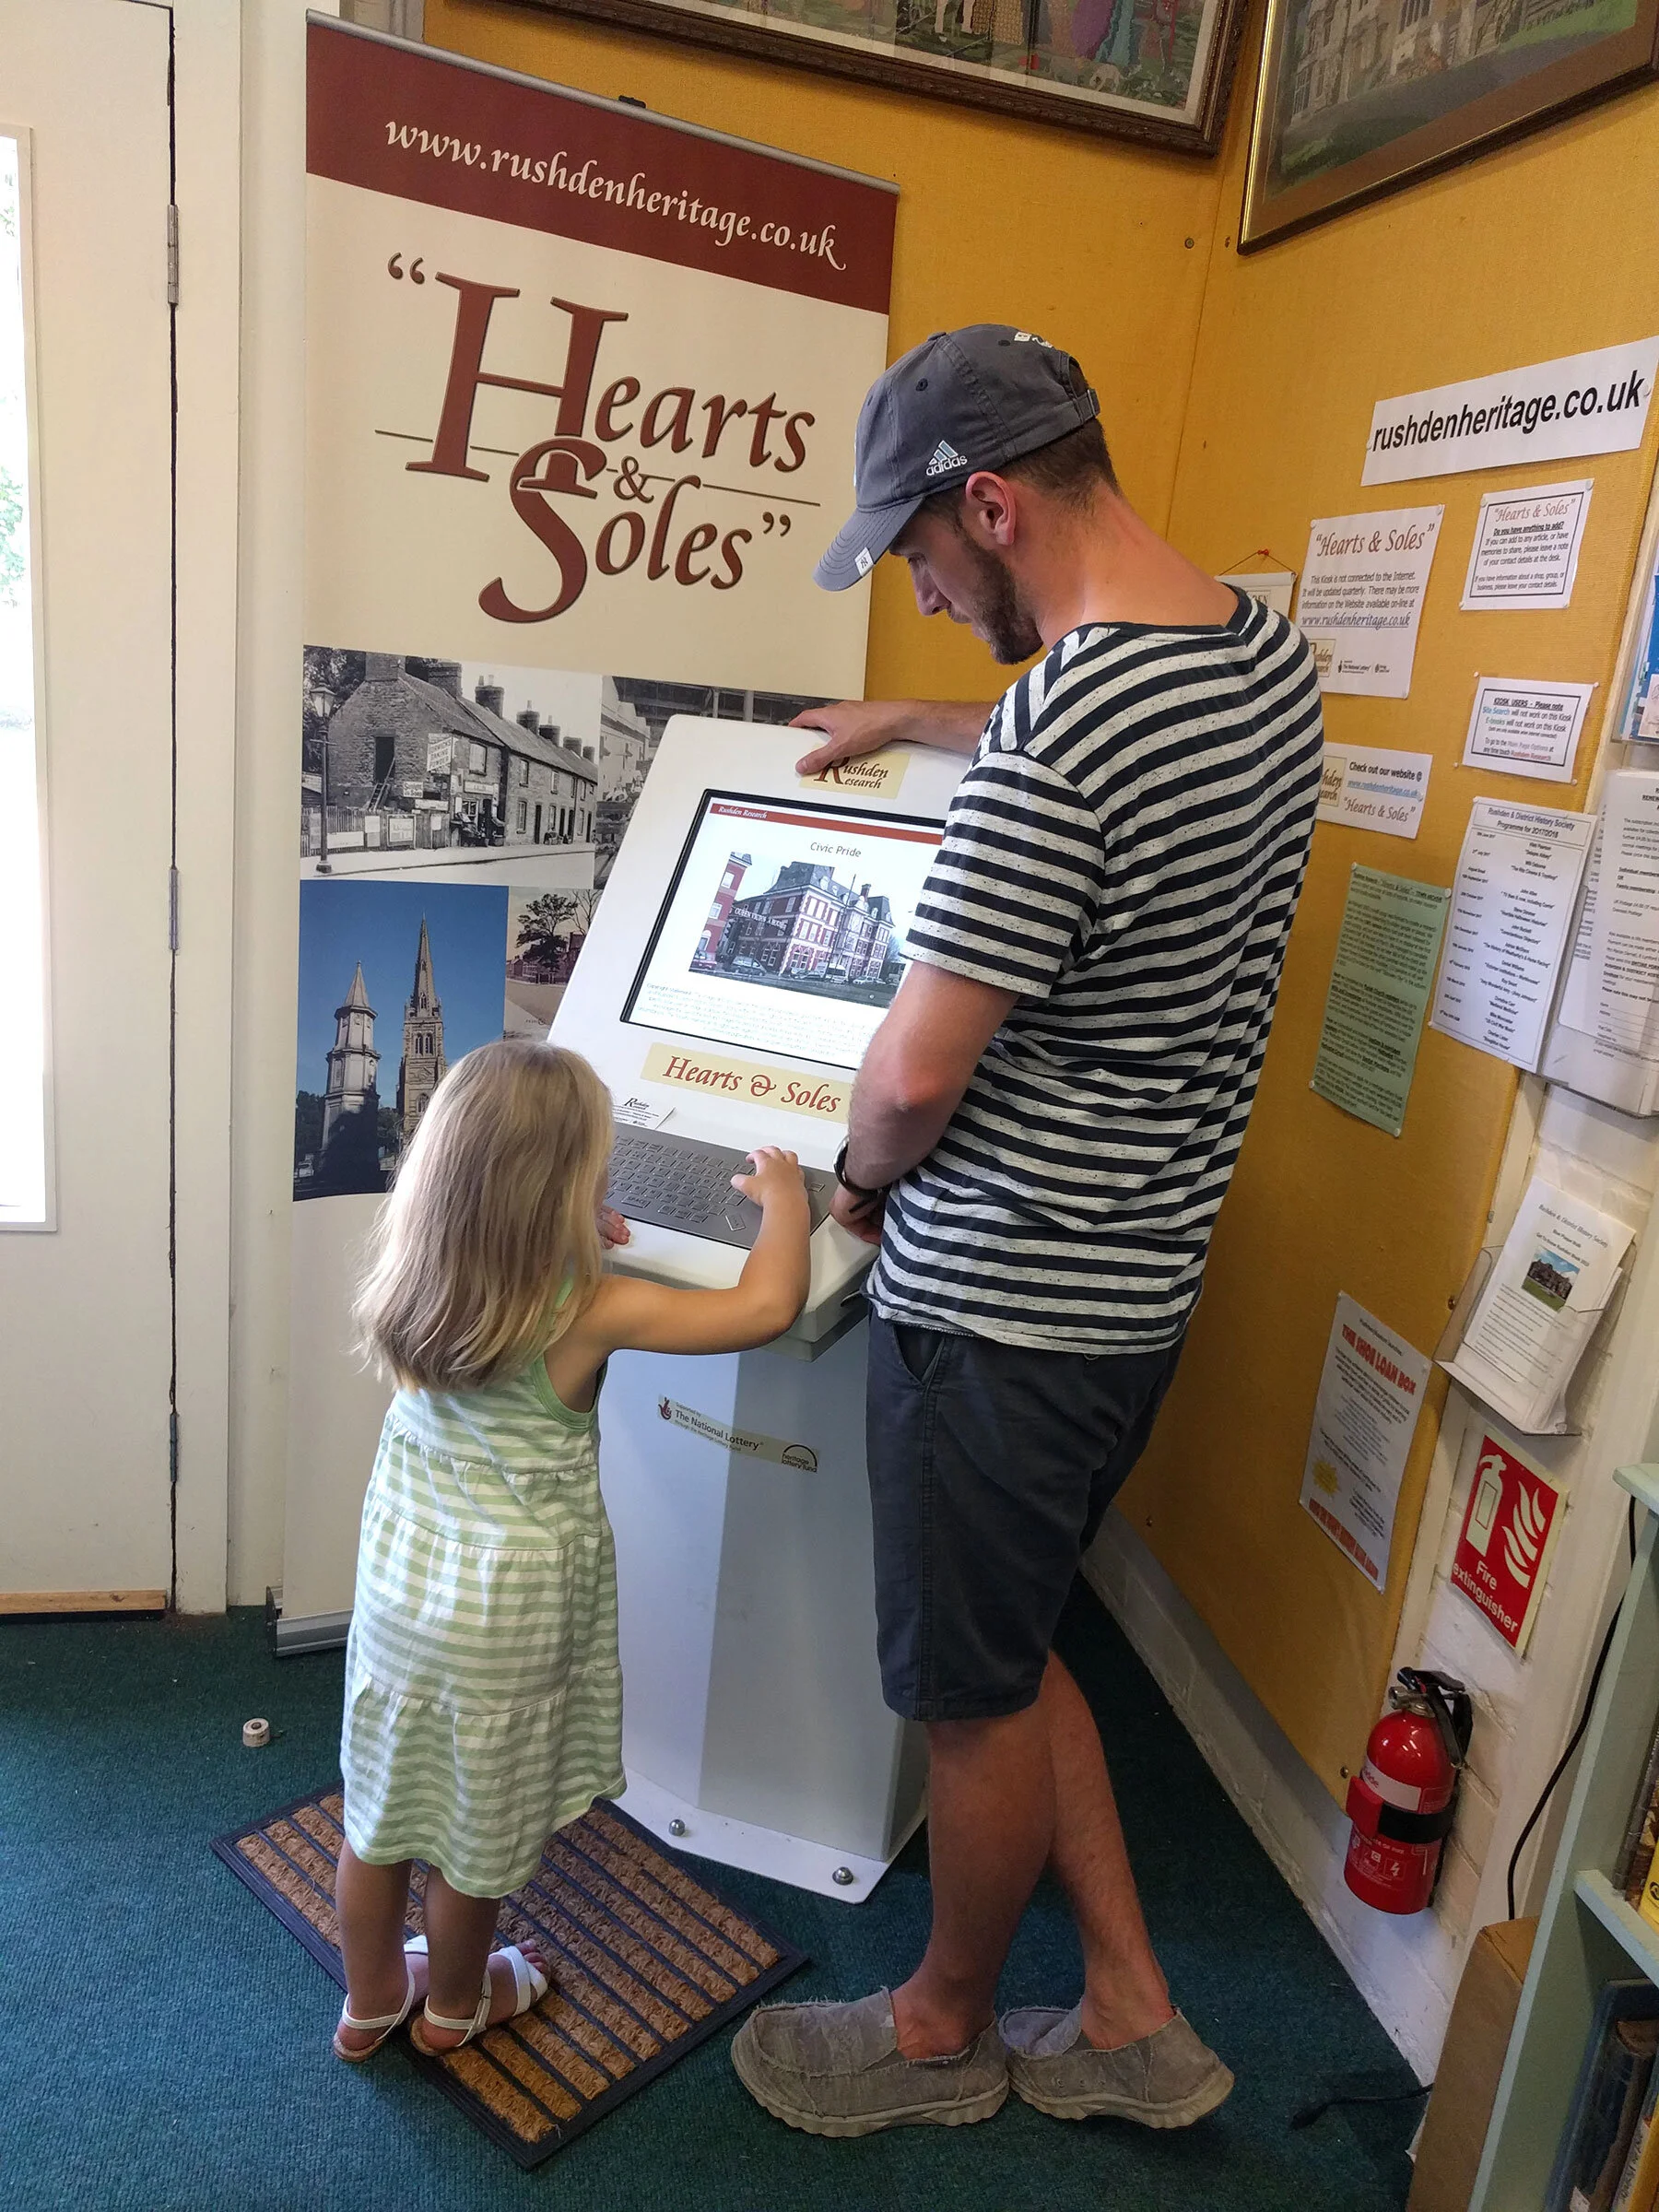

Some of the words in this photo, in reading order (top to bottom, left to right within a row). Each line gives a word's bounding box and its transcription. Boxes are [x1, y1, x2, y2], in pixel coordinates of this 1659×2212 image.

[384, 120, 847, 271] www.rushdenheritage.co.uk
[1372, 370, 1644, 453] rushdenheritage.co.uk
[926, 454, 968, 477] adidas
[613, 455, 654, 503] &
[1533, 505, 1541, 517] &
[1523, 524, 1544, 533] anything
[1369, 530, 1382, 552] &
[1508, 535, 1516, 544] add
[1533, 534, 1548, 542] article,
[1500, 557, 1516, 565] contact
[1518, 555, 1533, 564] details
[1311, 576, 1320, 584] This
[1321, 575, 1333, 583] Kiosk
[1347, 572, 1374, 582] connected
[1375, 573, 1382, 582] to
[1382, 572, 1392, 581] the
[1316, 588, 1323, 596] be
[1324, 586, 1341, 597] updated
[1369, 585, 1383, 594] There
[1385, 585, 1397, 596] may
[1398, 585, 1405, 594] be
[1406, 585, 1419, 594] more
[1344, 599, 1364, 608] Website
[1365, 599, 1389, 608] available
[1301, 612, 1411, 630] www.rushdenheritage.co.uk
[1494, 698, 1510, 706] KIOSK
[1512, 699, 1527, 708] USERS
[1535, 701, 1552, 710] Please
[1552, 703, 1563, 712] note
[1493, 707, 1510, 715] Search
[1559, 713, 1571, 722] Kiosk
[1553, 724, 1566, 732] Kiosk
[1349, 761, 1366, 771] Check
[1368, 766, 1378, 774] out
[1391, 769, 1416, 781] website
[1417, 771, 1422, 782] @
[718, 806, 742, 816] Rushden
[743, 809, 767, 819] Research
[1378, 806, 1384, 818] &
[810, 841, 833, 853] Civic
[835, 845, 862, 857] Pride
[663, 1055, 743, 1091] Hearts
[780, 1081, 841, 1113] Soles
[675, 1409, 689, 1423] The
[691, 1417, 724, 1438] National
[724, 1432, 759, 1451] Lottery
[782, 1453, 809, 1465] heritage
[1477, 1559, 1497, 1590] Fire
[1453, 1562, 1518, 1632] extinguisher
